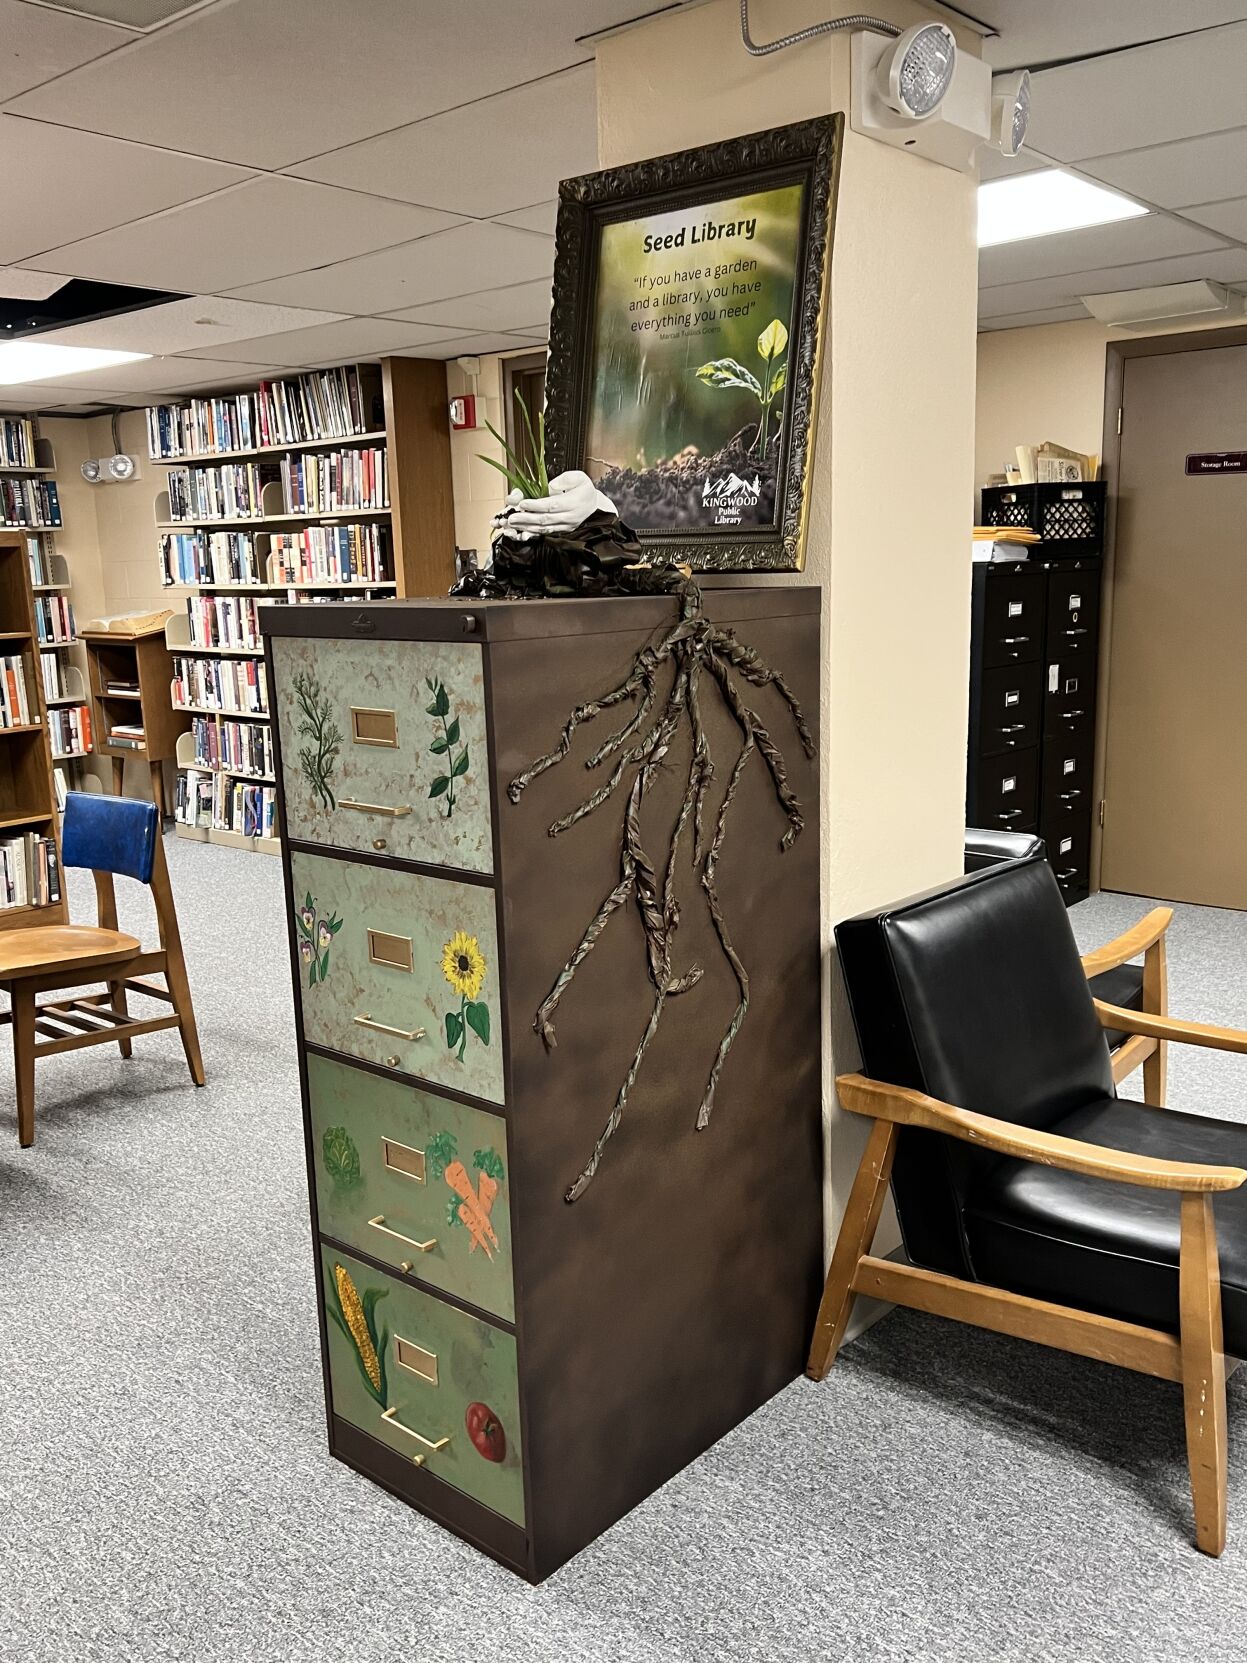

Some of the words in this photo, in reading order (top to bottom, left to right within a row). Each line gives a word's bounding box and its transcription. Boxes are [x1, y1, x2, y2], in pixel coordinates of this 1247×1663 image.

[643, 227, 686, 254] Seed
[691, 218, 757, 243] Library
[650, 273, 671, 291] you
[674, 268, 701, 284] have
[704, 267, 712, 278] a
[714, 258, 757, 279] garden
[629, 296, 650, 312] and
[652, 298, 659, 307] a
[662, 290, 703, 307] library,
[706, 286, 728, 304] you
[732, 280, 762, 296] have
[631, 311, 692, 332] everything
[694, 309, 716, 326] you
[1200, 461, 1222, 469] Storage
[702, 496, 758, 507] KINGWOOD
[718, 507, 740, 515] Public
[714, 515, 742, 526] Library
